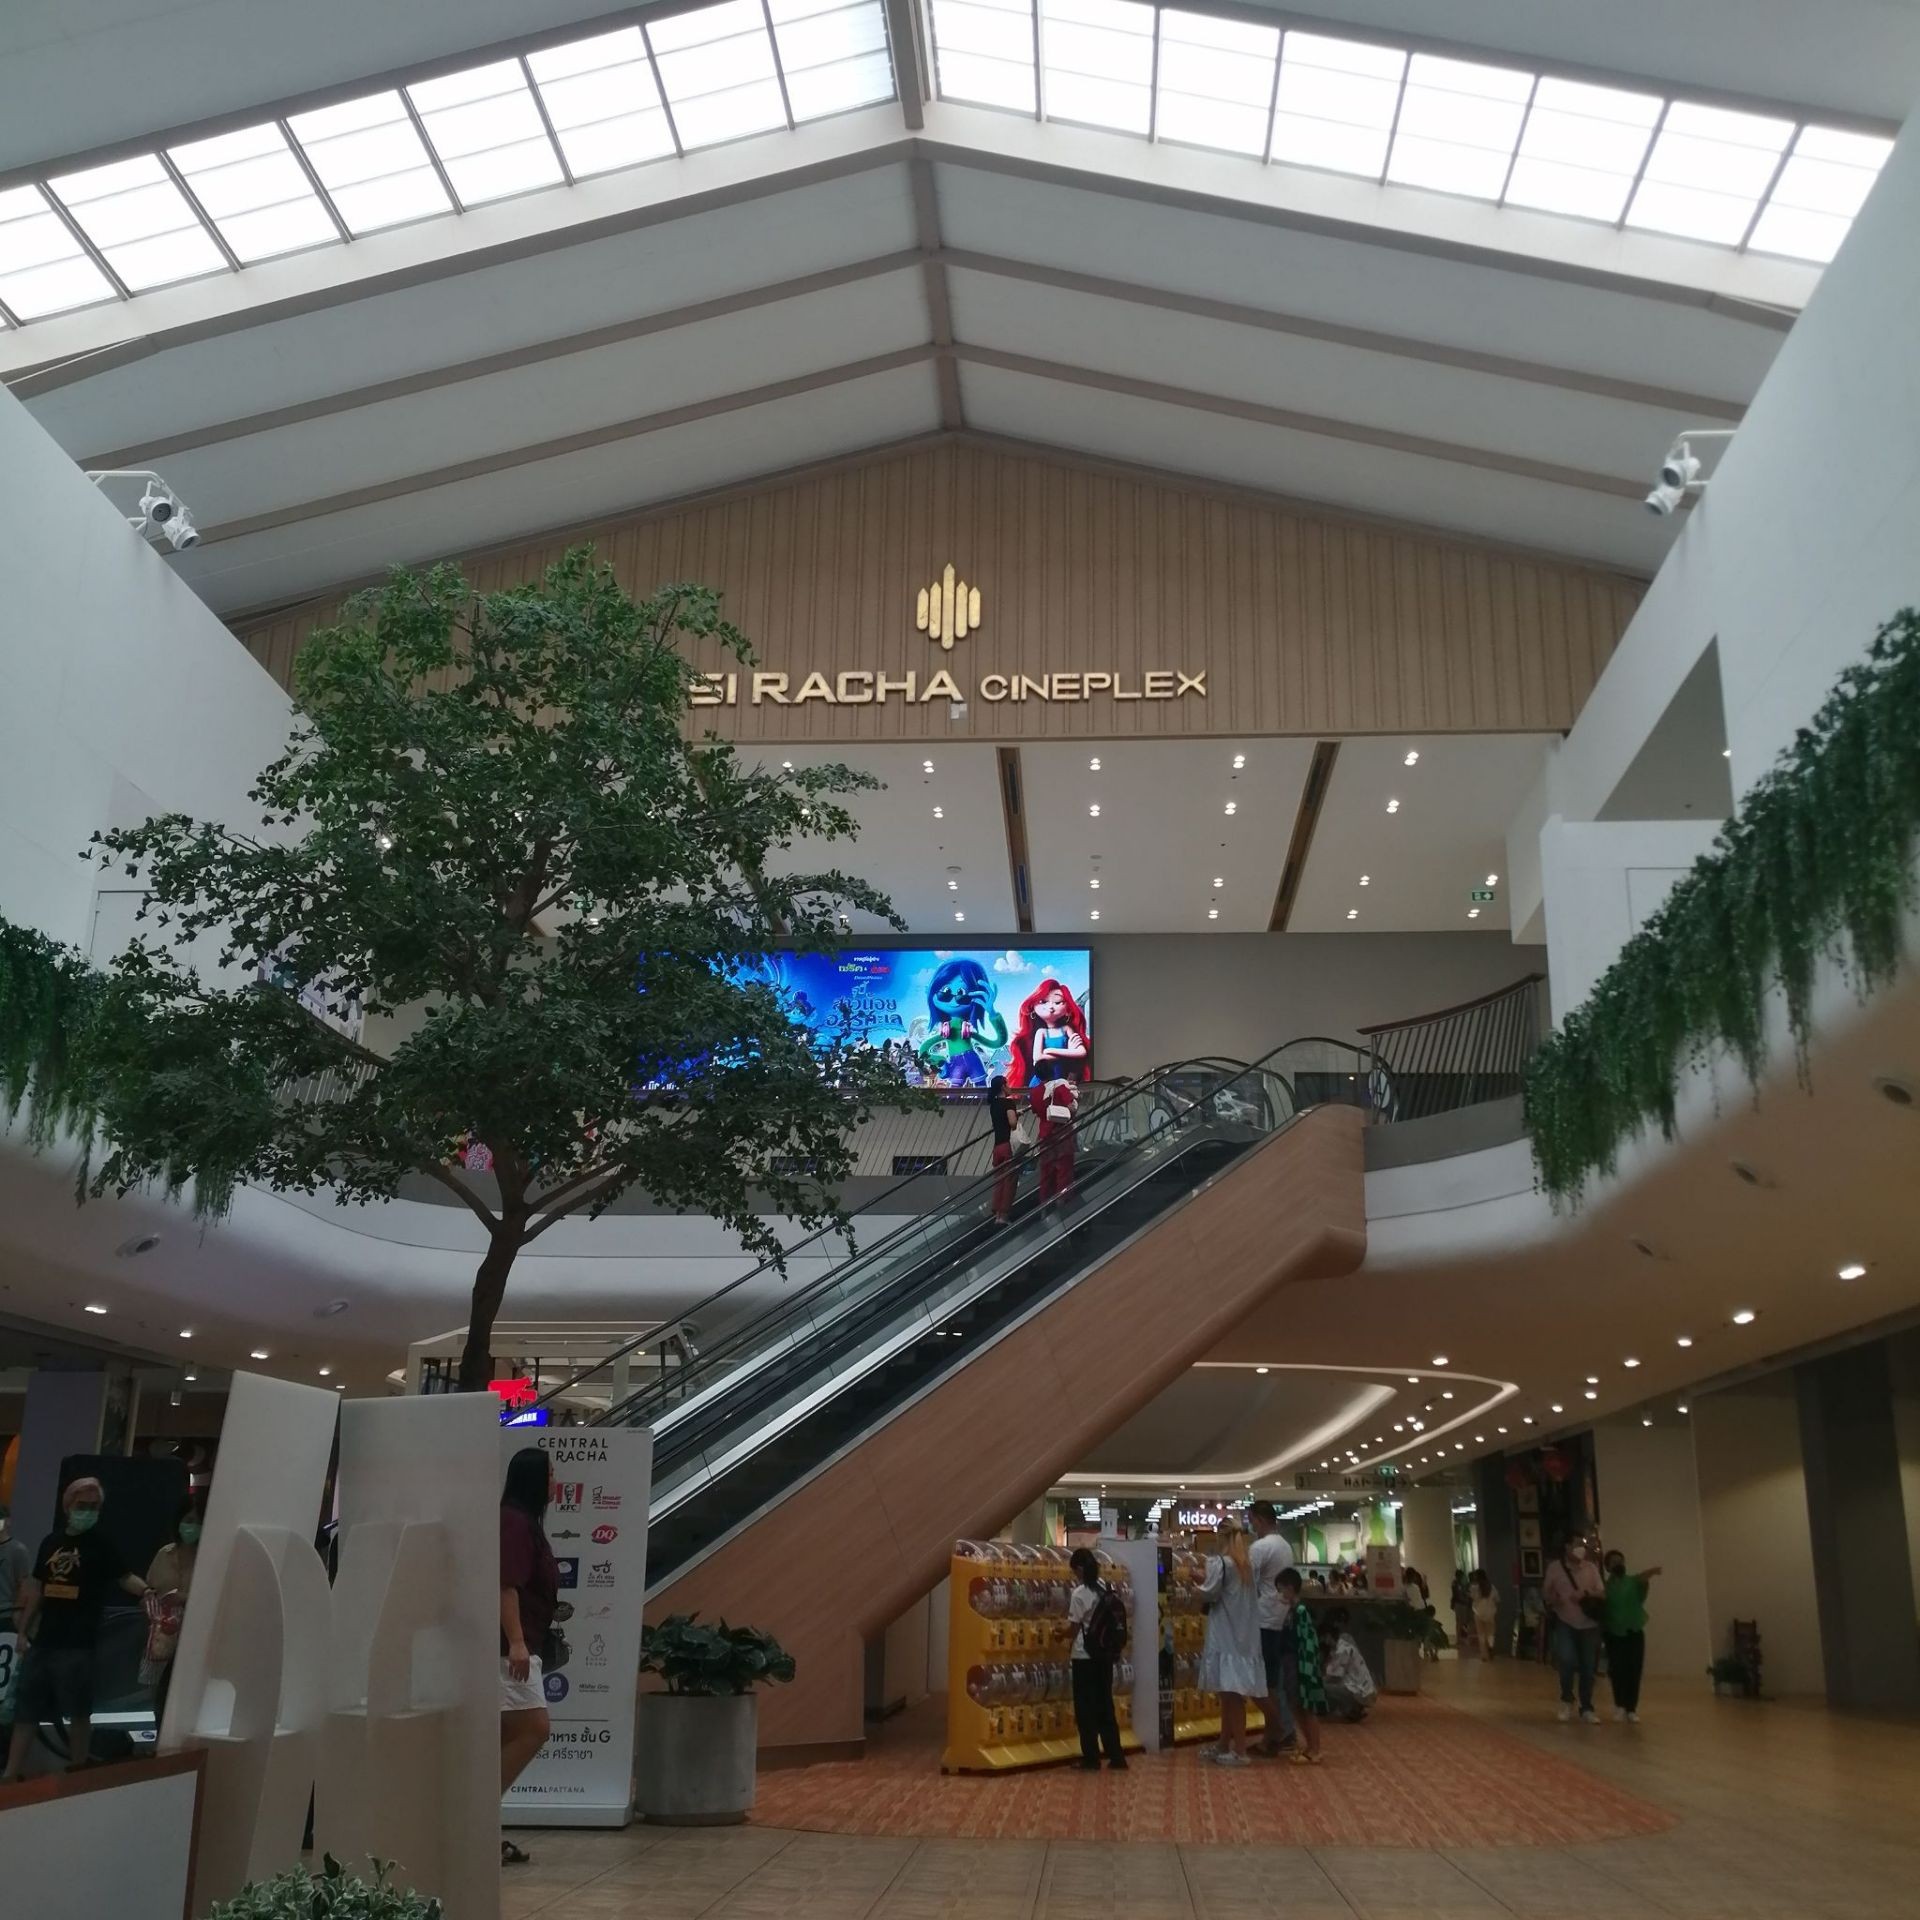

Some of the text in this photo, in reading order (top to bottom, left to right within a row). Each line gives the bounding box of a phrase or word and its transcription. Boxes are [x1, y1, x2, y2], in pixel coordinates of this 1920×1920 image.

[688, 669, 1207, 705] SI RACHA CINEPLEX
[537, 1437, 609, 1449] CENTRAL
[555, 1450, 608, 1463] RACHA
[559, 1504, 577, 1512] KFC
[1178, 1510, 1222, 1525] kidzo
[595, 1529, 615, 1541] DQ
[598, 1730, 611, 1743] G
[552, 1747, 593, 1760] ศรีราชา
[510, 1785, 585, 1793] CENTRALPATTANA
